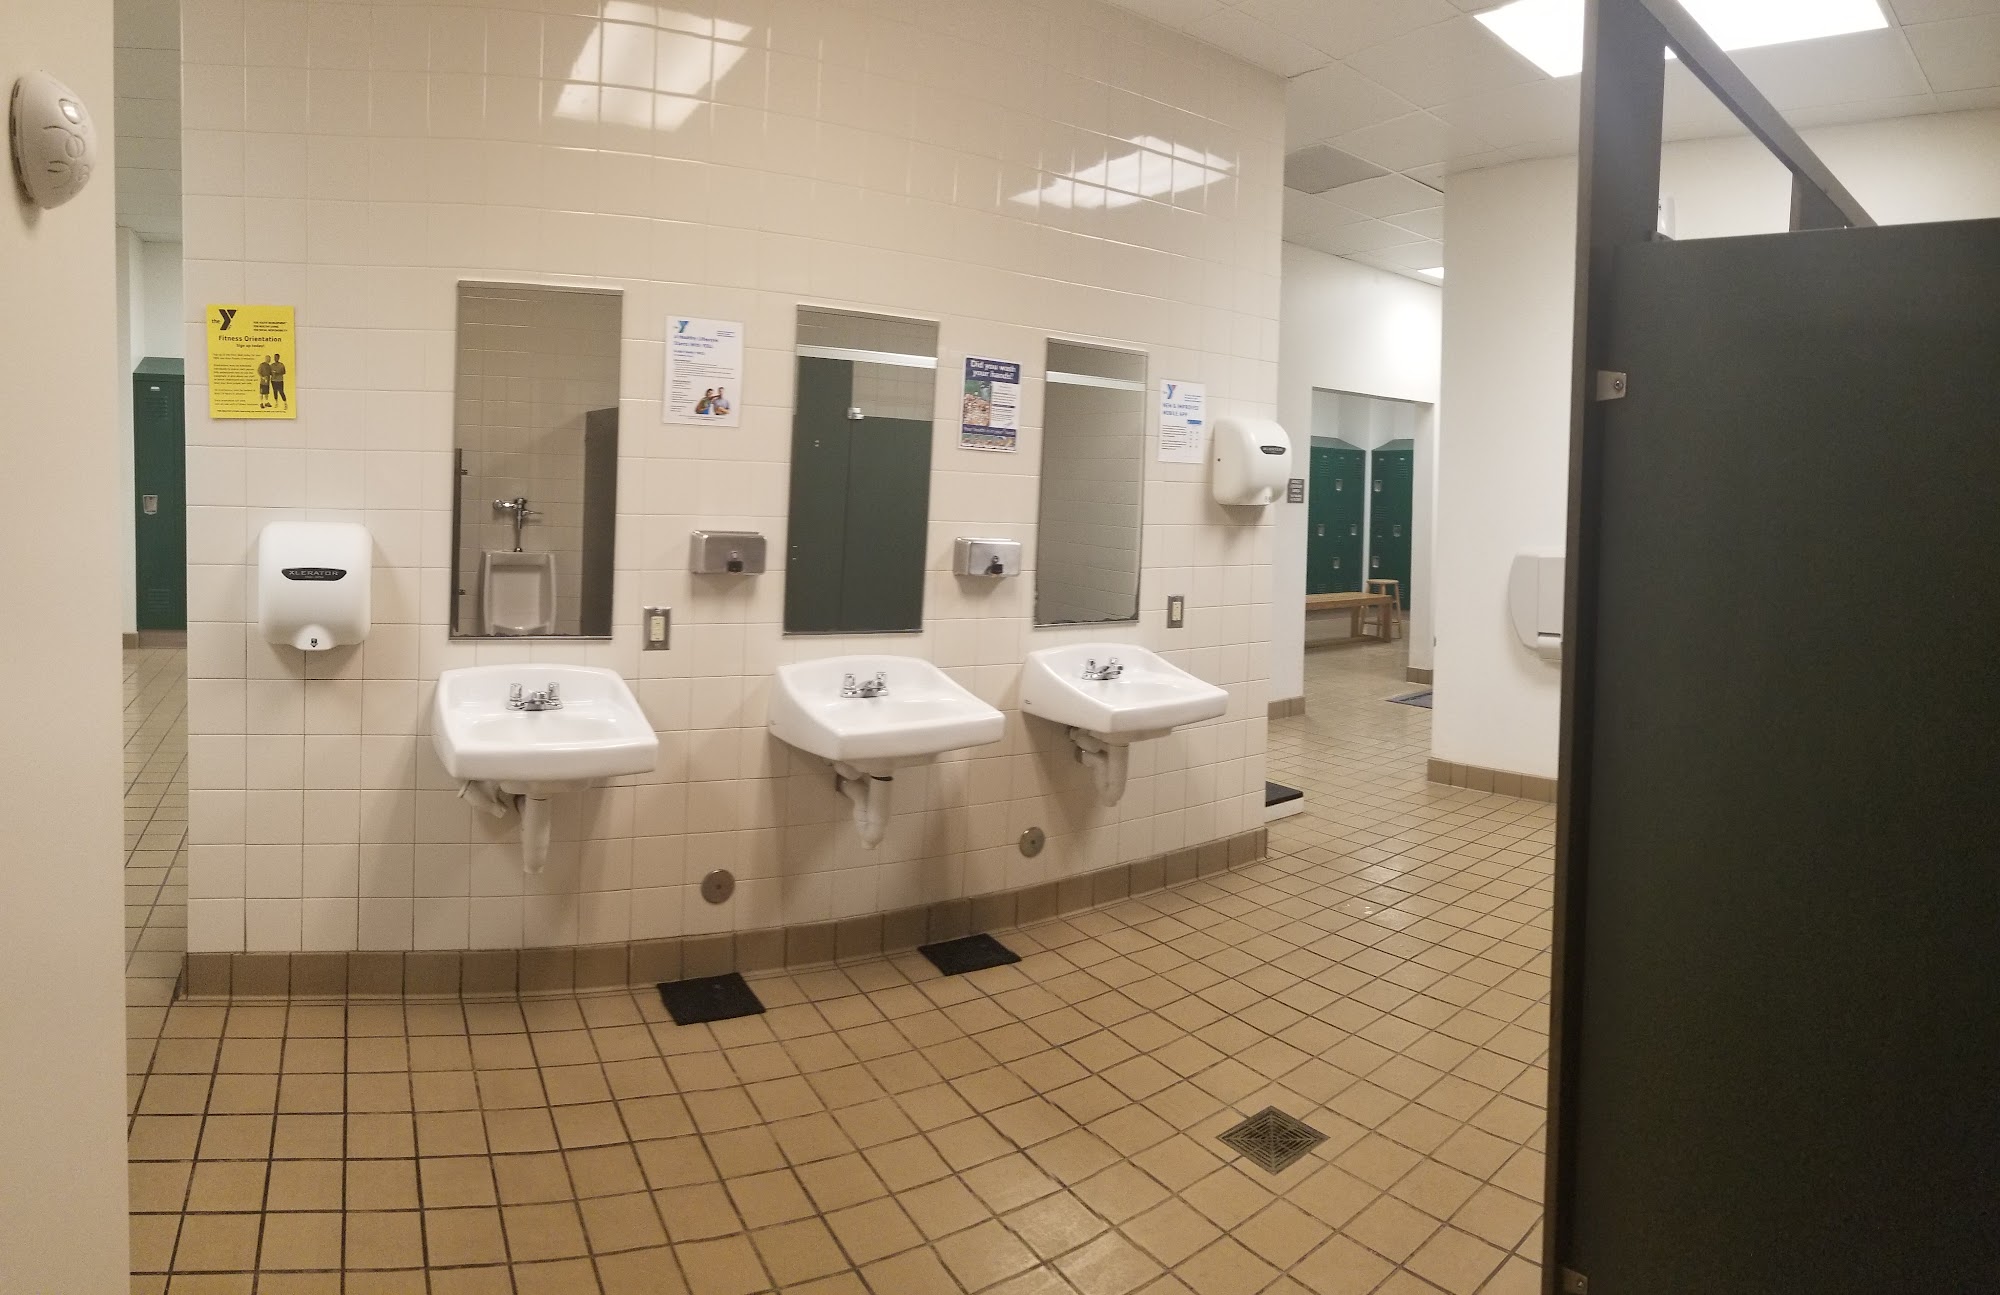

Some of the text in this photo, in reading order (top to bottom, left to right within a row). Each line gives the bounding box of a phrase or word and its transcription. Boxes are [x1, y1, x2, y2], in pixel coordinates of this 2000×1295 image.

[219, 309, 237, 330] Y
[970, 360, 984, 368] Did
[984, 363, 999, 371] you
